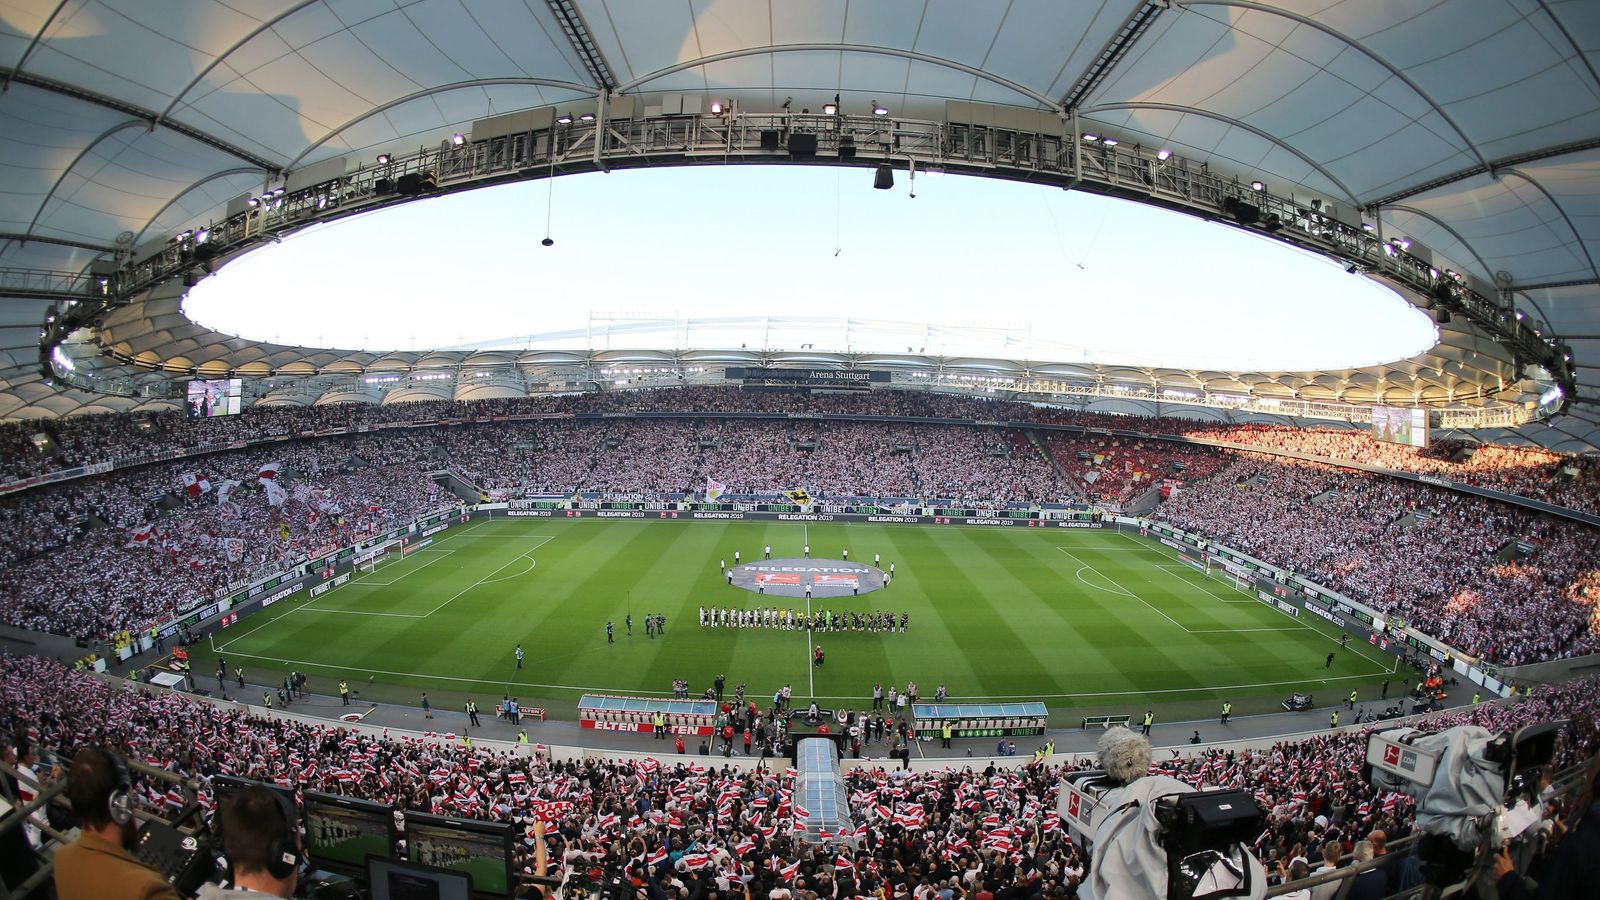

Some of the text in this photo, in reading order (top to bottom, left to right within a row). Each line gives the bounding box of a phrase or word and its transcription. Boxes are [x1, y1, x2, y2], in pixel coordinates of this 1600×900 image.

[809, 371, 871, 382] Arena Stuttgart
[280, 572, 295, 582] UNIBET
[334, 574, 350, 586] UNIBET
[249, 585, 265, 597] UNIBET
[314, 582, 331, 594] UNIBET
[262, 582, 303, 607] RELEGATION 2019
[1259, 591, 1274, 605] UNIBET
[200, 605, 218, 619] UNIBET
[1277, 600, 1294, 614] UNIBET
[1305, 601, 1344, 627] RELEGATION 2019
[1355, 611, 1371, 623] UNIBET
[594, 721, 638, 732] ELTEN
